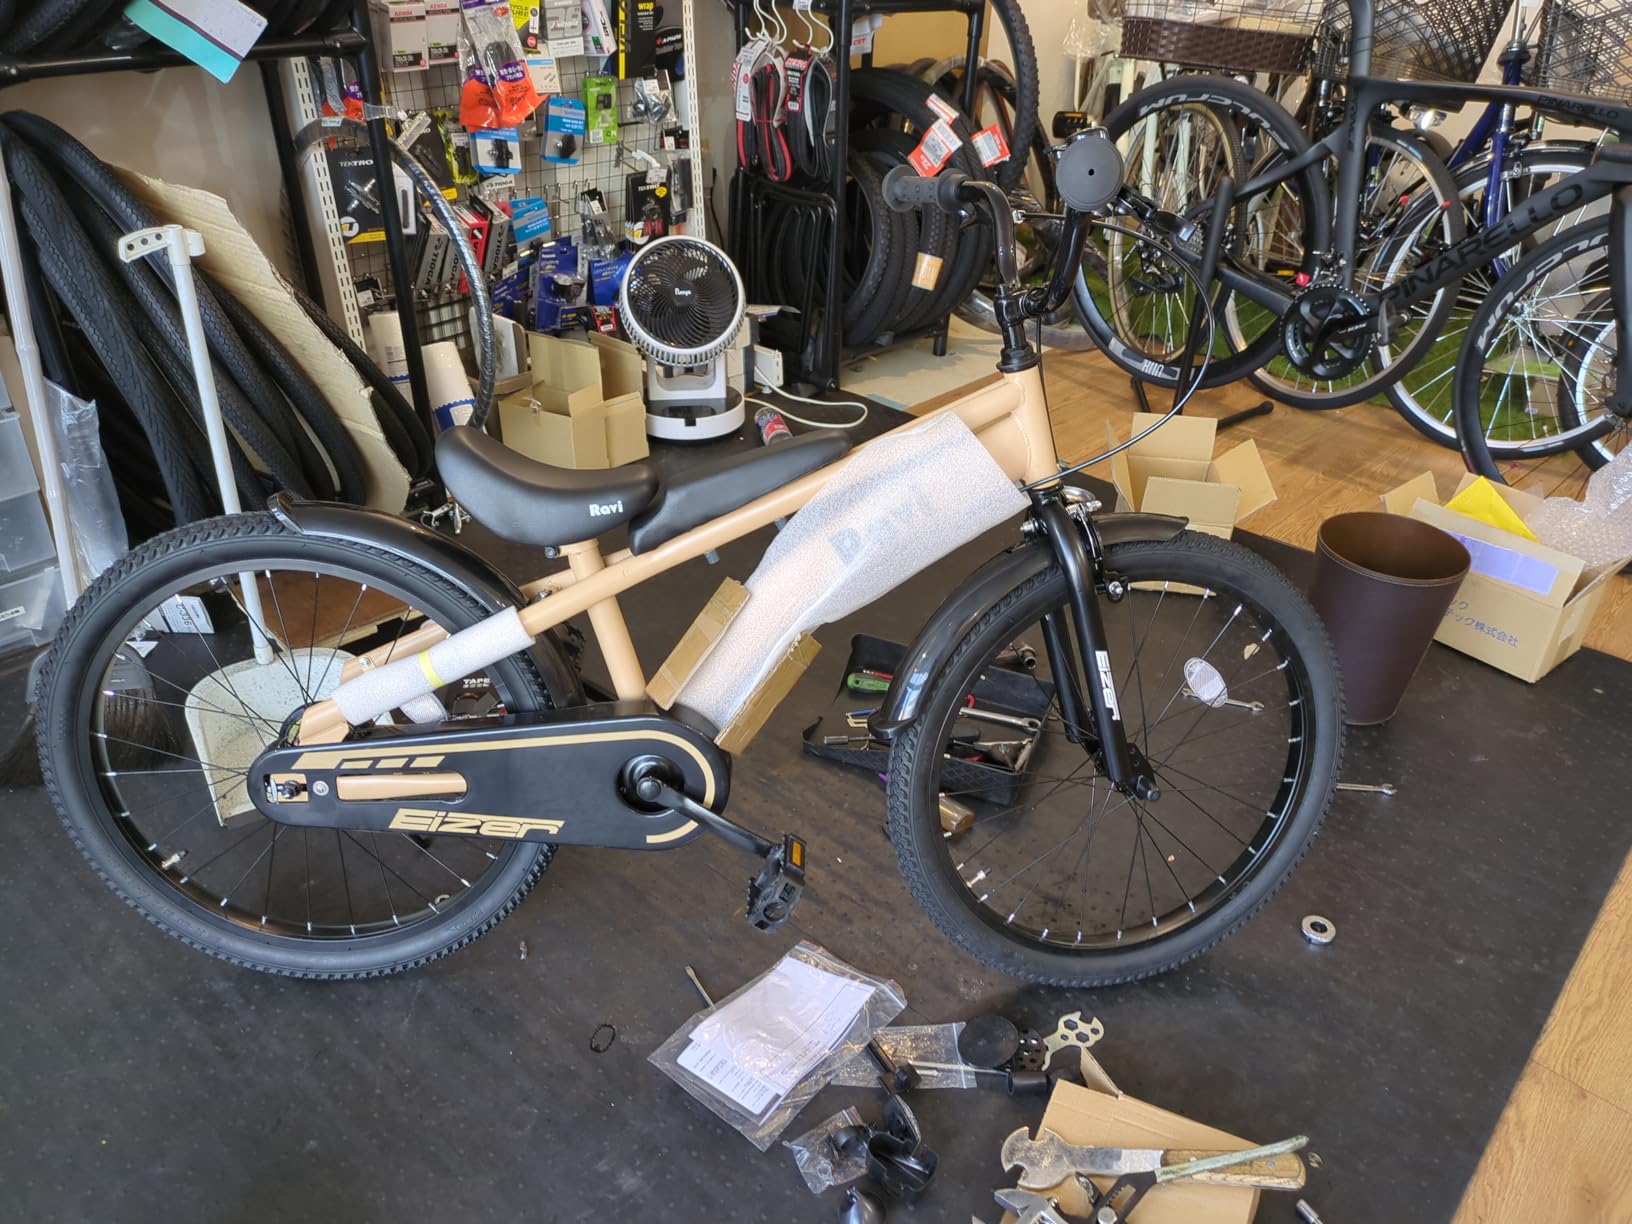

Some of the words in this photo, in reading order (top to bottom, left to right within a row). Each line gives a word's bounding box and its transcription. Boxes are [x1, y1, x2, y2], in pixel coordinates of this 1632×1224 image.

[637, 2, 655, 11] wrap
[1138, 93, 1290, 150] FULCRUM
[339, 158, 374, 169] TEKTRO
[1378, 183, 1583, 303] PINARELLO
[425, 251, 441, 286] TIOGA
[589, 500, 624, 517] Ravi
[463, 677, 490, 685] TAPE
[388, 808, 566, 839] Eizer
